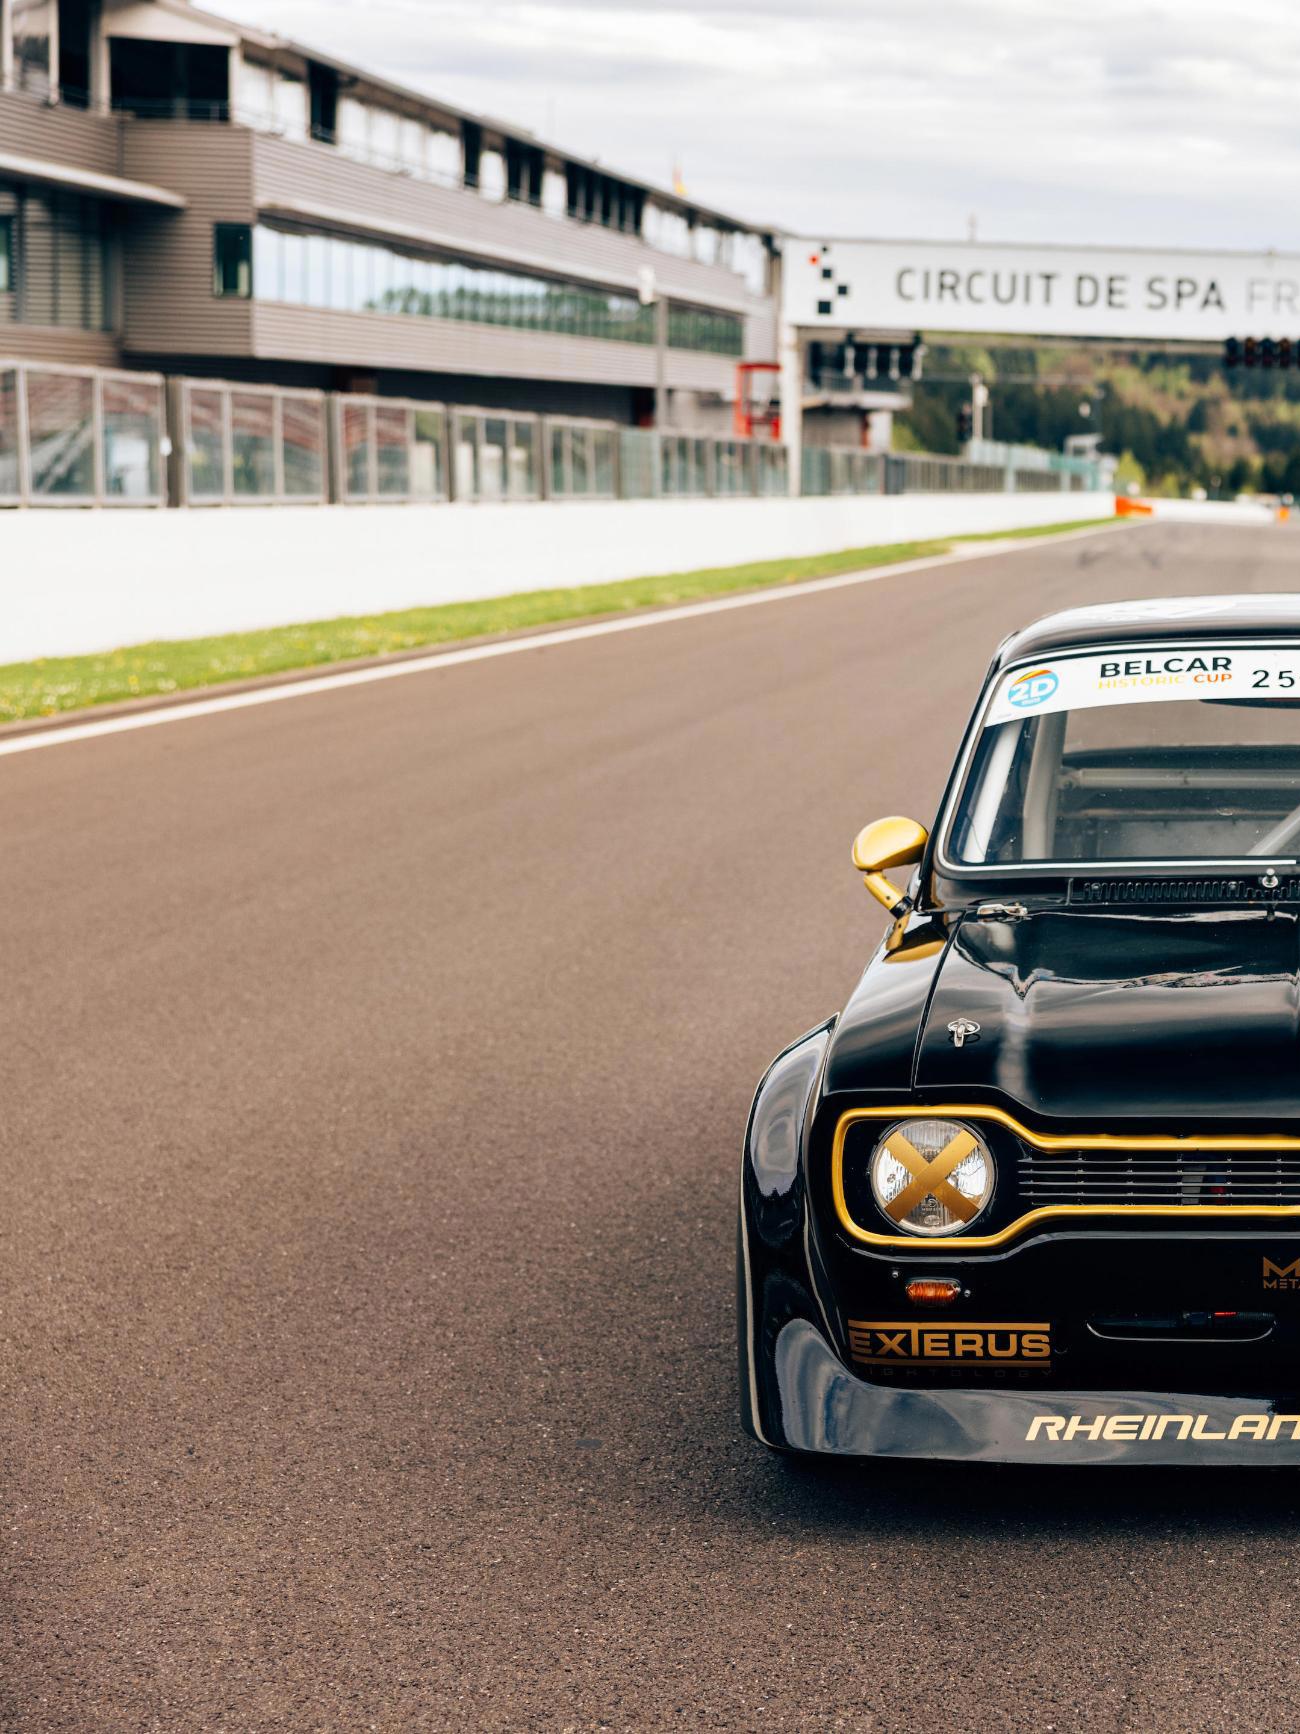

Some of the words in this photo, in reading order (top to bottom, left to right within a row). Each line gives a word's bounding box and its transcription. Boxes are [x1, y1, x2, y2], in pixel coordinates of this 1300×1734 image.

[896, 268, 1057, 305] CIRCUIT
[1076, 273, 1128, 308] DE
[1147, 276, 1225, 312] SPA
[1100, 656, 1232, 679] BELCAR
[1010, 677, 1057, 703] 2D
[1098, 674, 1187, 689] HISTORIC
[1193, 673, 1233, 684] CUP
[848, 1320, 1051, 1358] EXTERUS
[853, 1367, 1053, 1378] IGHTOLOGY
